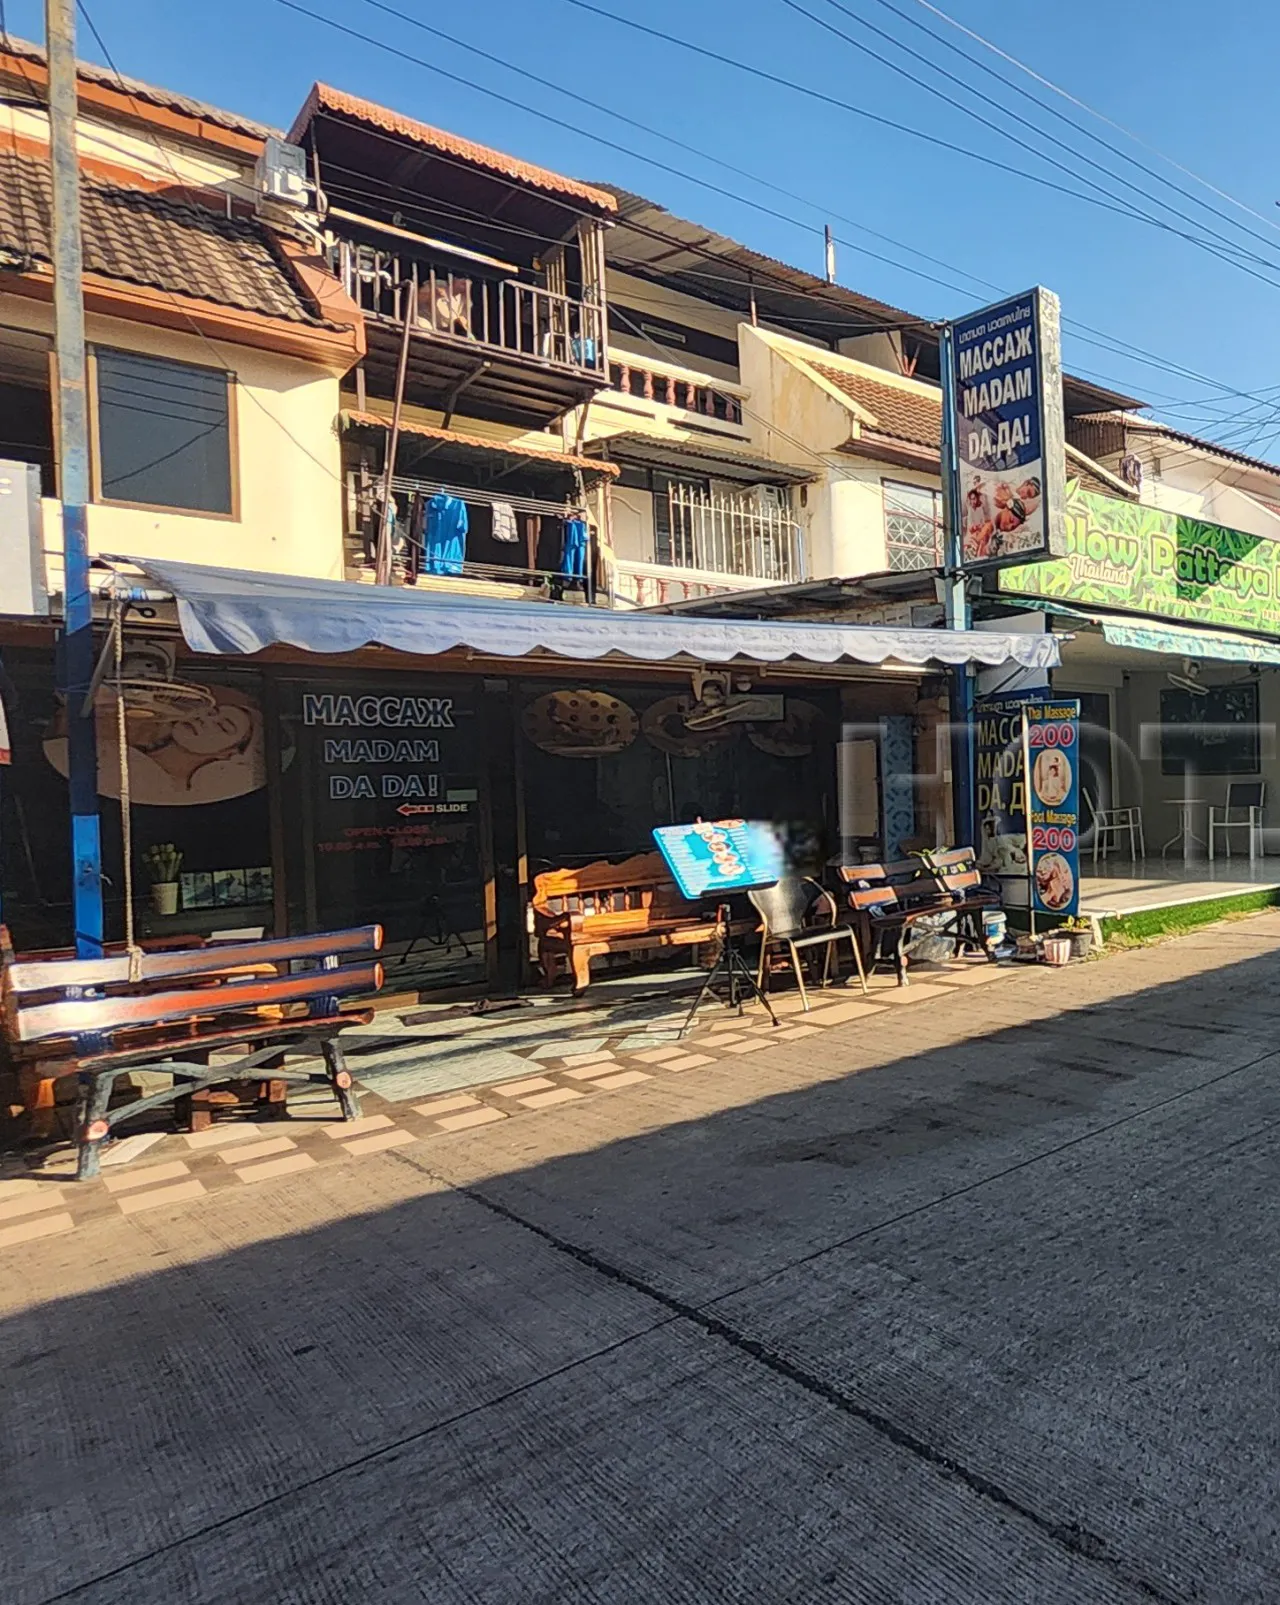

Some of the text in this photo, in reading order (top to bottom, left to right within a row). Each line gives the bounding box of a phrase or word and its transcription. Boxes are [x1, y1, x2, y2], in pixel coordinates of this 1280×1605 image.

[959, 324, 1032, 380] МАССАЖ
[963, 367, 1032, 418] MADAM
[1068, 553, 1131, 585] Thailand
[1150, 533, 1272, 598] Pattaya
[303, 695, 454, 727] МАССАЖ
[1044, 705, 1076, 720] Massage
[977, 717, 1023, 746] МАСС
[1029, 722, 1075, 747] 200
[324, 740, 439, 763] MADAM
[978, 751, 1024, 779] MADA
[330, 775, 376, 799] DA
[436, 804, 468, 813] SLIDE
[1046, 809, 1077, 827] Massage
[1031, 827, 1076, 851] 200
